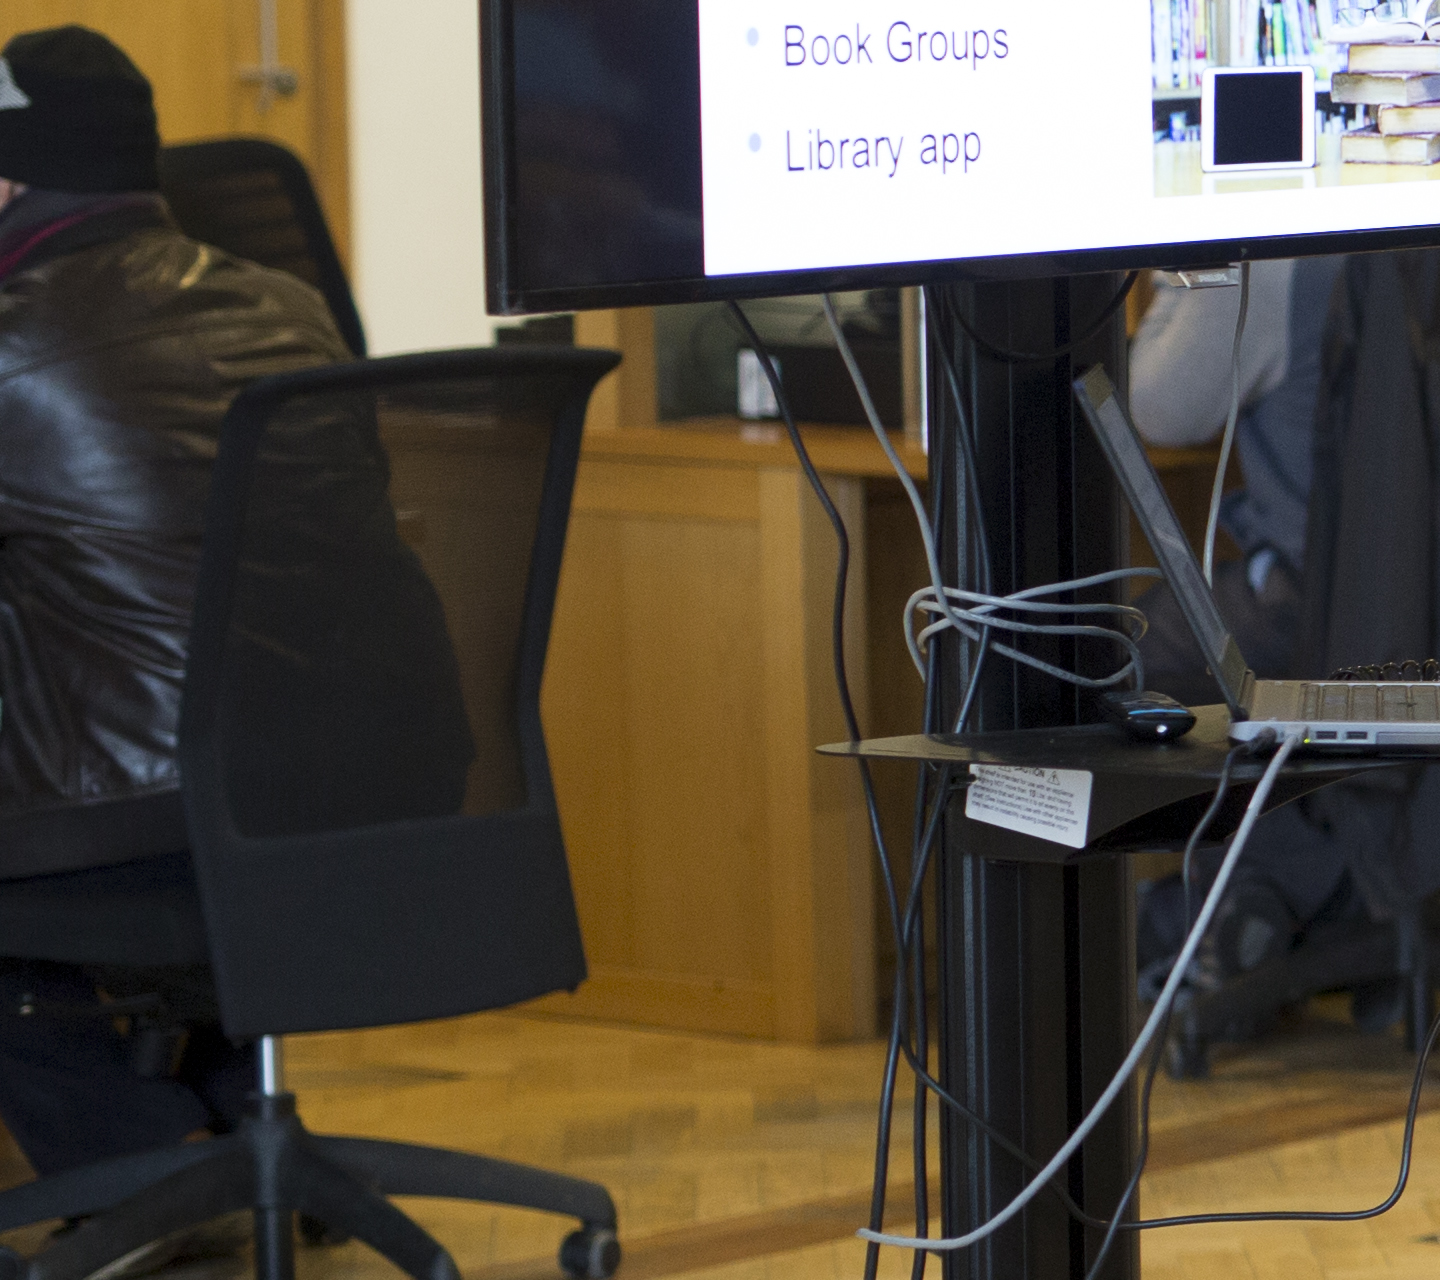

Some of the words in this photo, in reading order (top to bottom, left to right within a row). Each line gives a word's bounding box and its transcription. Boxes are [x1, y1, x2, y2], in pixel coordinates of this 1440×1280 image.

[784, 24, 873, 67] Book
[886, 20, 1009, 70] Groups
[786, 129, 903, 178] Library
[920, 131, 981, 174] app
